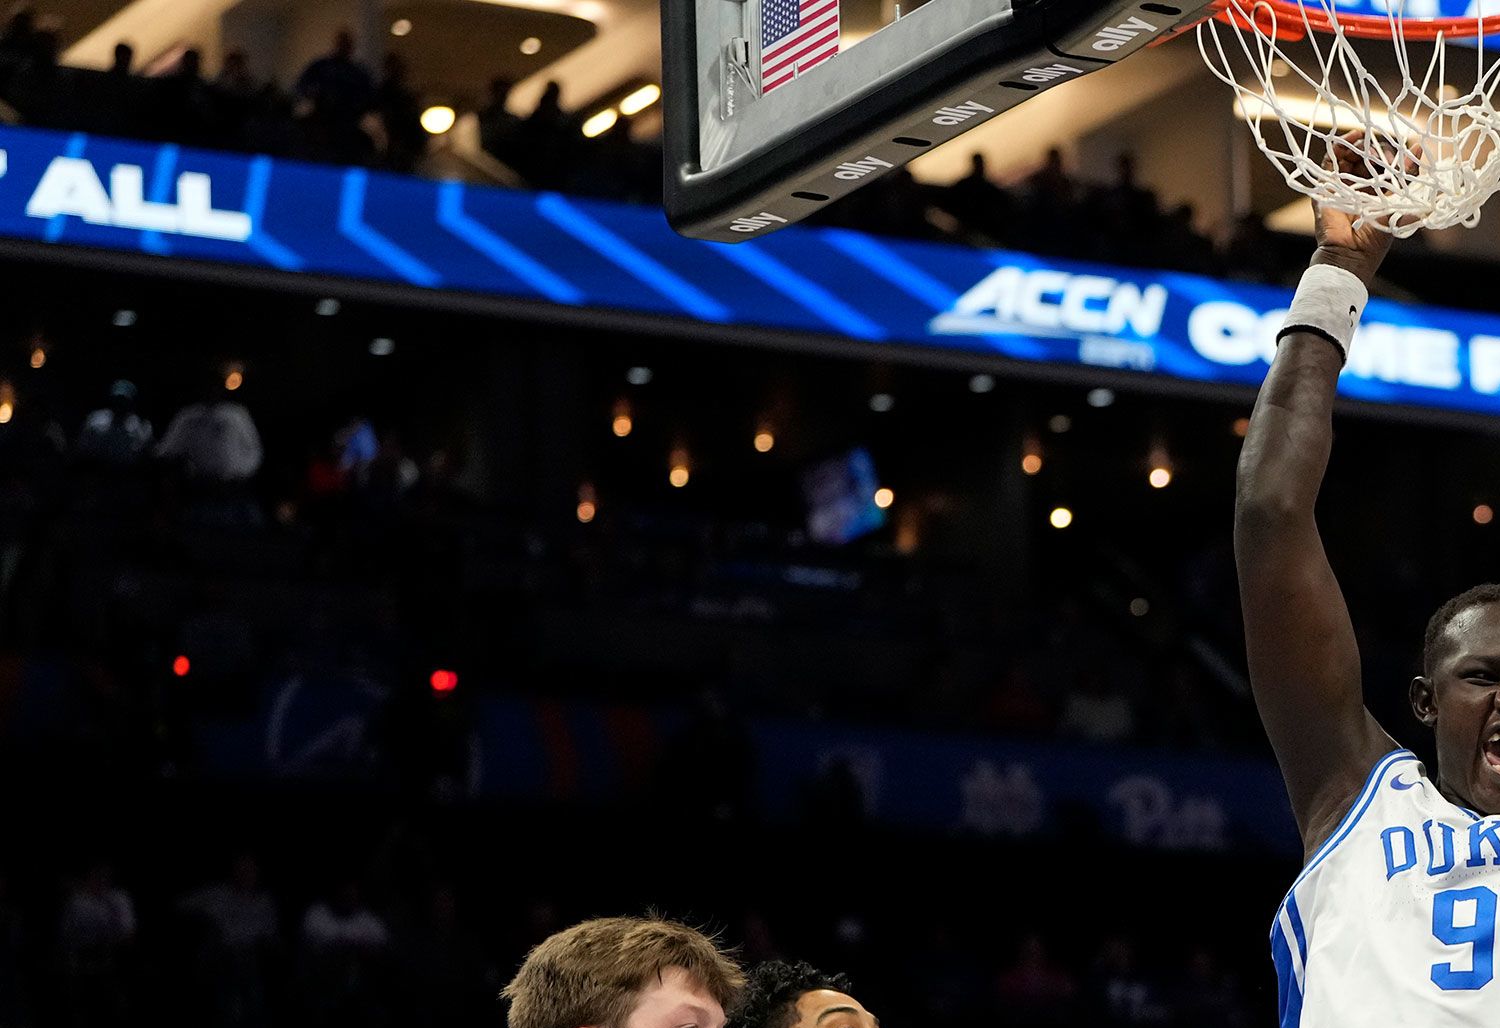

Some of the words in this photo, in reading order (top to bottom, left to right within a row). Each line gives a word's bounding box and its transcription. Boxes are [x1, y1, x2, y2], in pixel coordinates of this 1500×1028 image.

[1091, 15, 1158, 52] ally
[1022, 63, 1084, 84] ally
[932, 100, 995, 127] ally
[834, 156, 894, 181] ally
[24, 155, 252, 243] ALL
[730, 211, 788, 233] ally
[934, 266, 1168, 338] ACCN
[1430, 885, 1499, 991] 9
